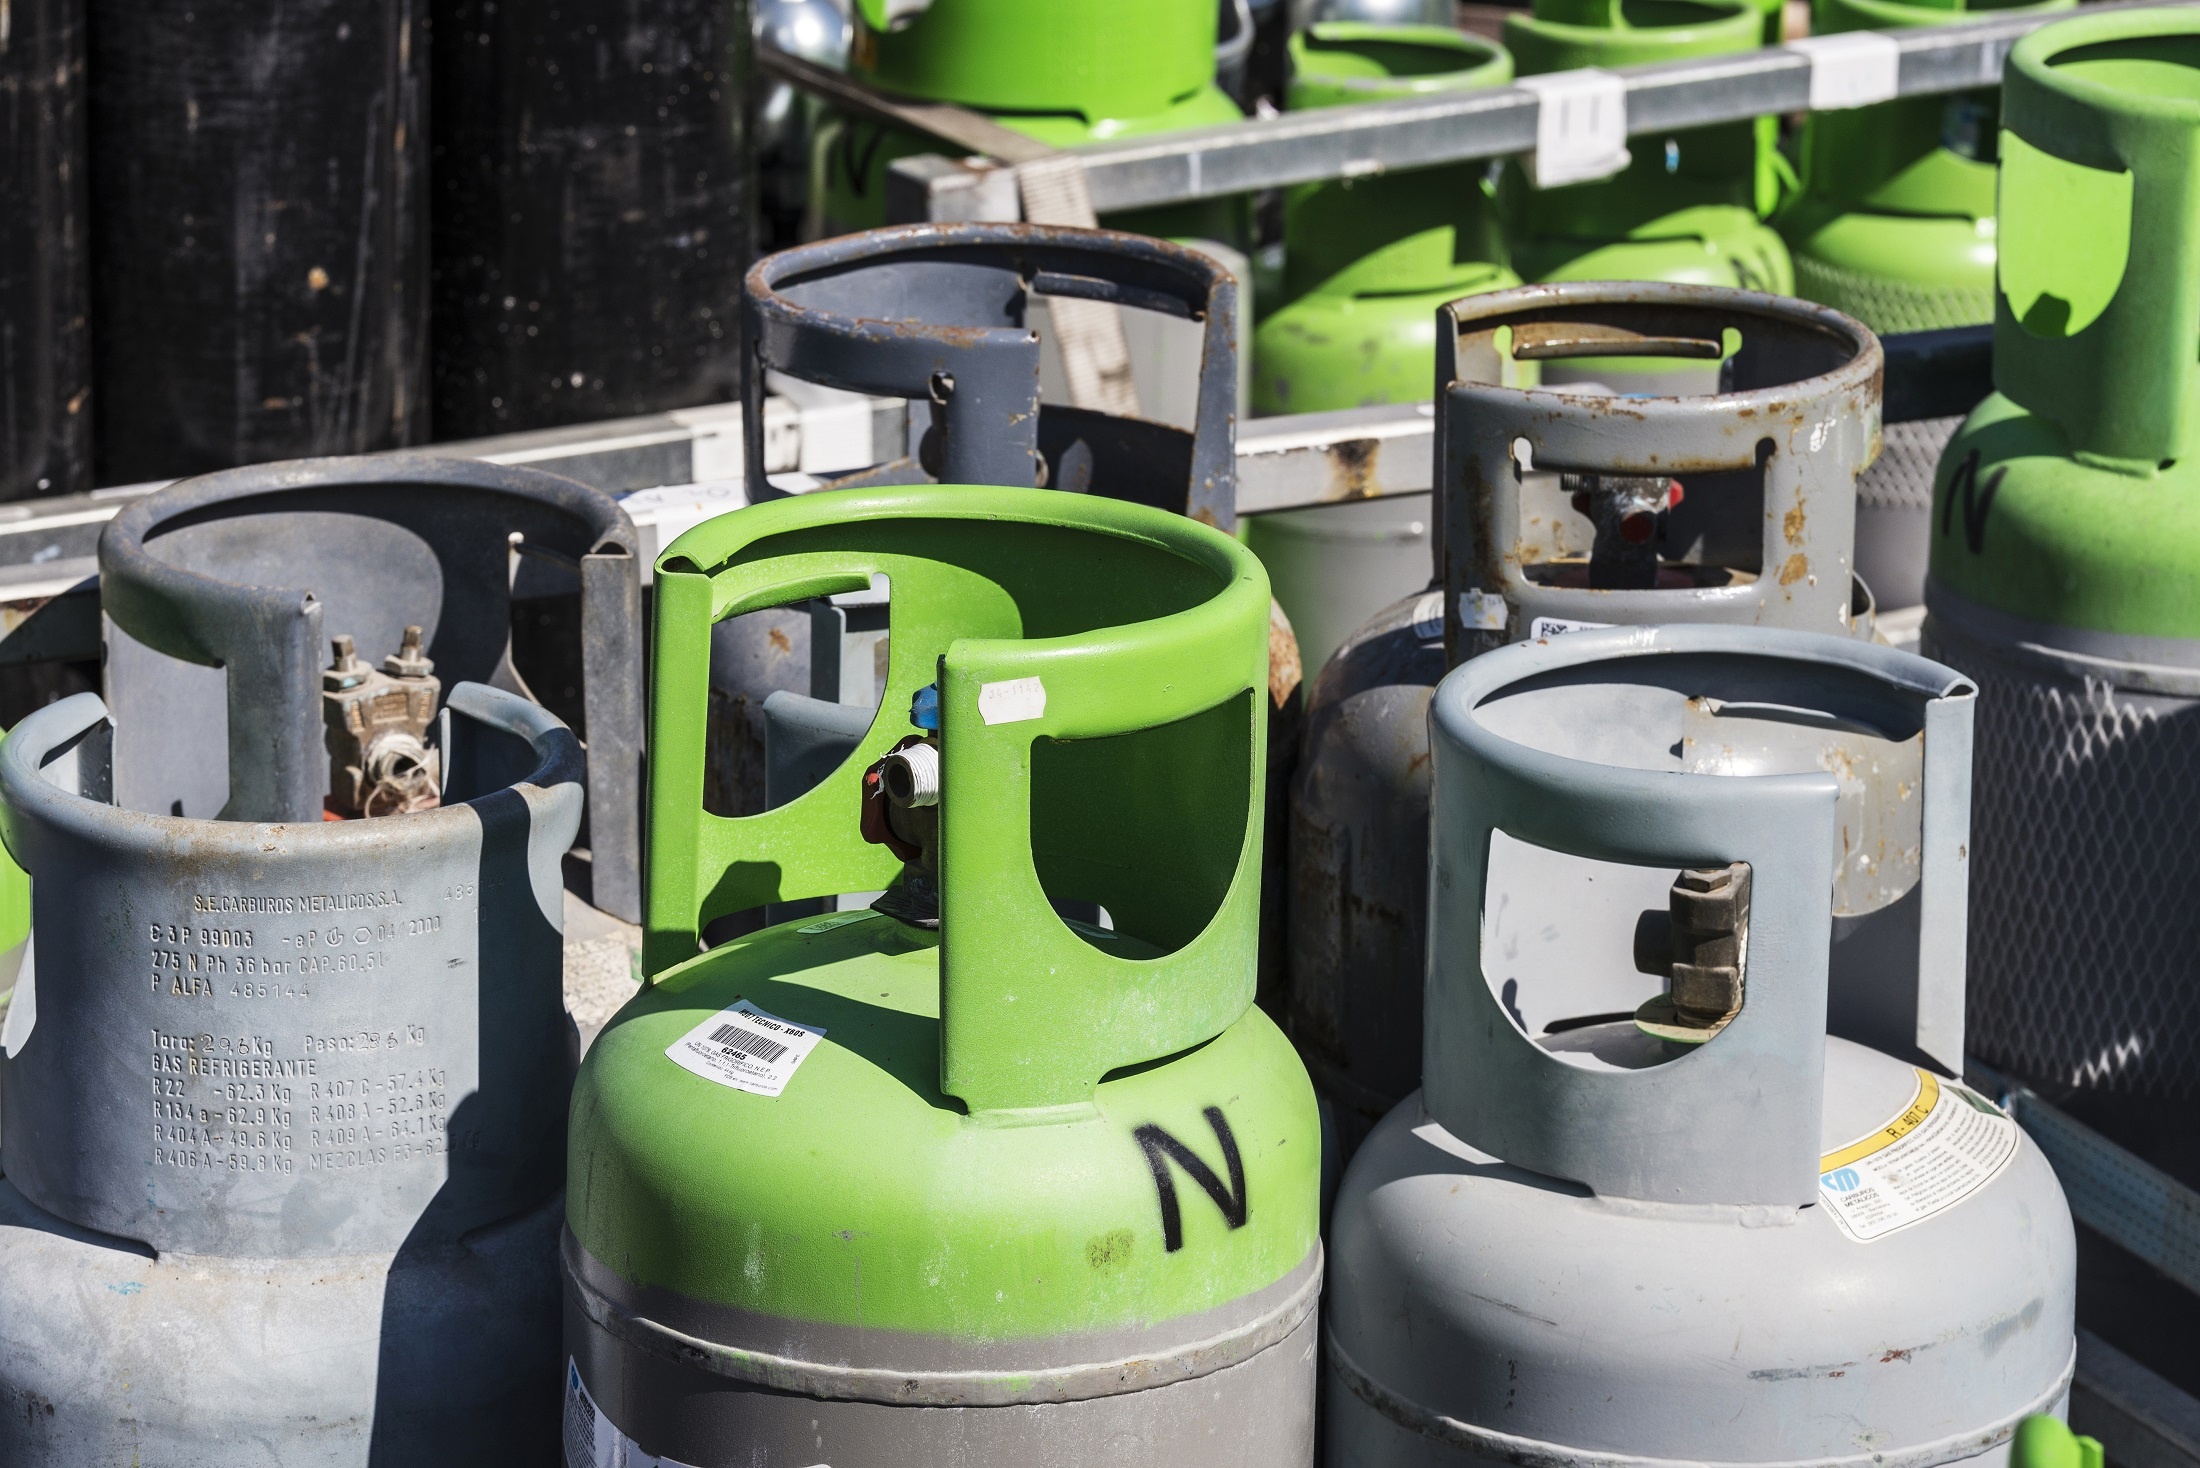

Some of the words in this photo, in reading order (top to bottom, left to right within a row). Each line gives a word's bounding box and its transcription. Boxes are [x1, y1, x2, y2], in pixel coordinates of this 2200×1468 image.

[1942, 449, 2008, 555] N
[201, 928, 254, 948] 99003
[151, 950, 181, 970] 275
[206, 955, 227, 974] Ph
[235, 957, 256, 975] 36
[261, 957, 291, 975] bar
[151, 973, 160, 992] P
[172, 975, 212, 996] ALFA
[230, 982, 310, 999] 485144
[406, 1024, 425, 1046] Kg
[751, 1016, 781, 1031] TECNICO
[152, 1053, 182, 1074] GAS
[189, 1057, 316, 1078] REFRIGERANTE
[721, 1046, 748, 1061] 62465
[1886, 1128, 1902, 1139] R
[1902, 1111, 1922, 1126] 407
[1915, 1105, 1929, 1114] C
[309, 1149, 386, 1171] MEZCLAS
[1132, 1106, 1247, 1253] N
